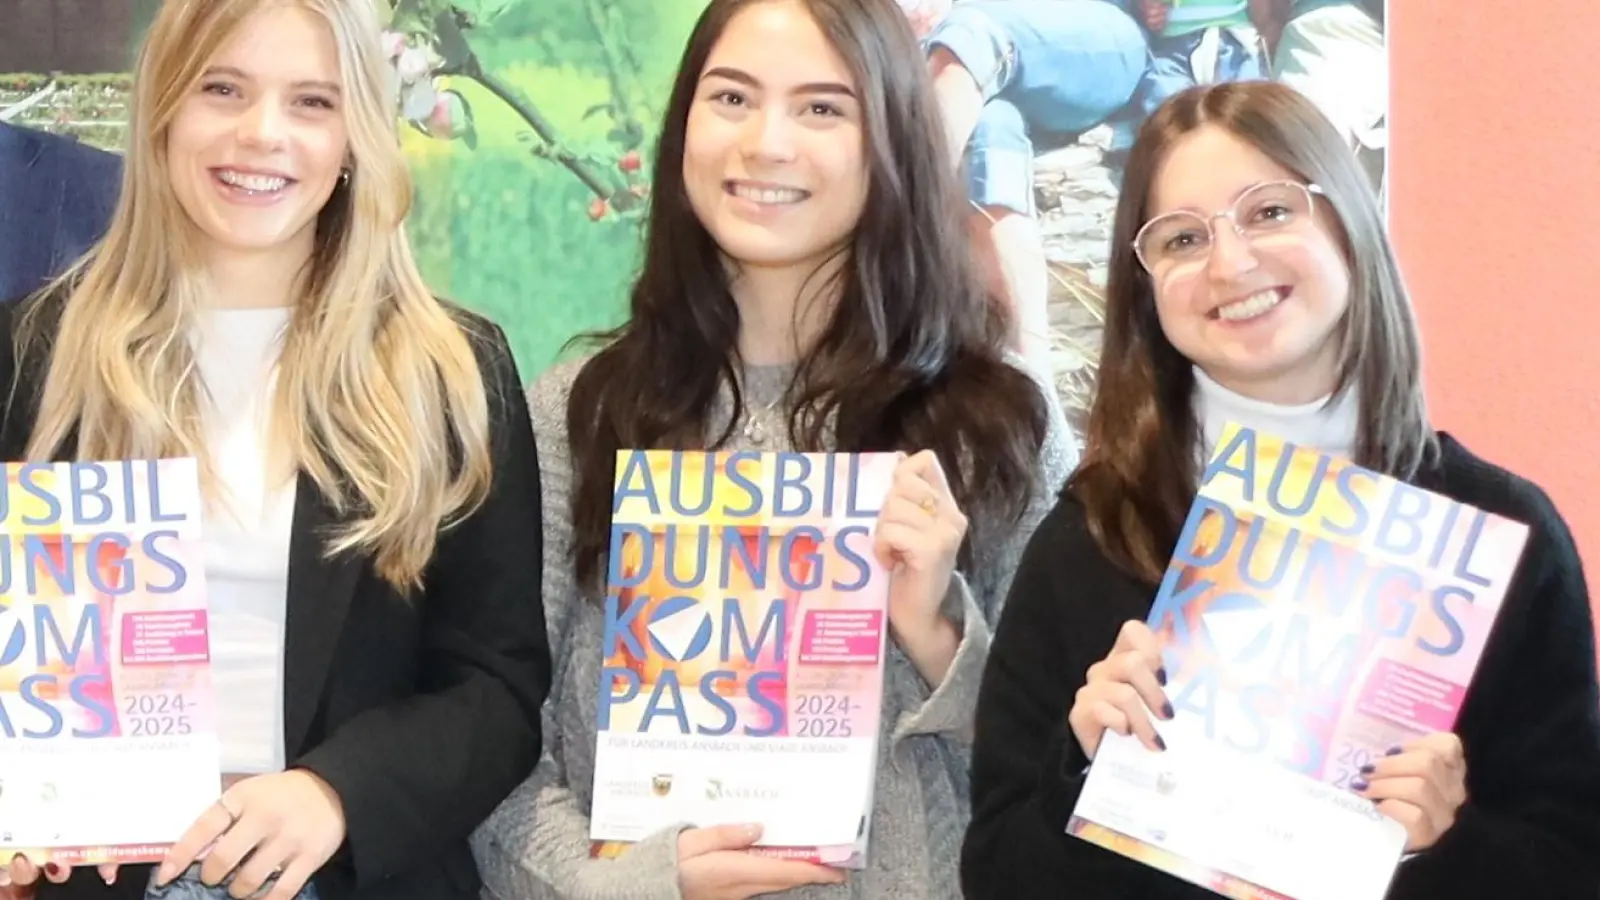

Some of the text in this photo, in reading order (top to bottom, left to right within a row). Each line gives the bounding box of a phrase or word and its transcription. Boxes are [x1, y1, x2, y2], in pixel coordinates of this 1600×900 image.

[0, 460, 187, 526] SBIL
[612, 450, 881, 518] AUSBIL
[1201, 428, 1491, 587] AUSBIL
[0, 530, 188, 596] NGS
[607, 523, 871, 592] DUNGS
[1173, 494, 1476, 657] DUNGS
[603, 596, 788, 663] KOM
[124, 692, 197, 716] 2024-
[129, 716, 192, 738] 2025
[597, 668, 785, 737] PASS
[794, 694, 861, 716] 2024-
[797, 717, 852, 738] 2025
[632, 739, 688, 750] LANDKREIS
